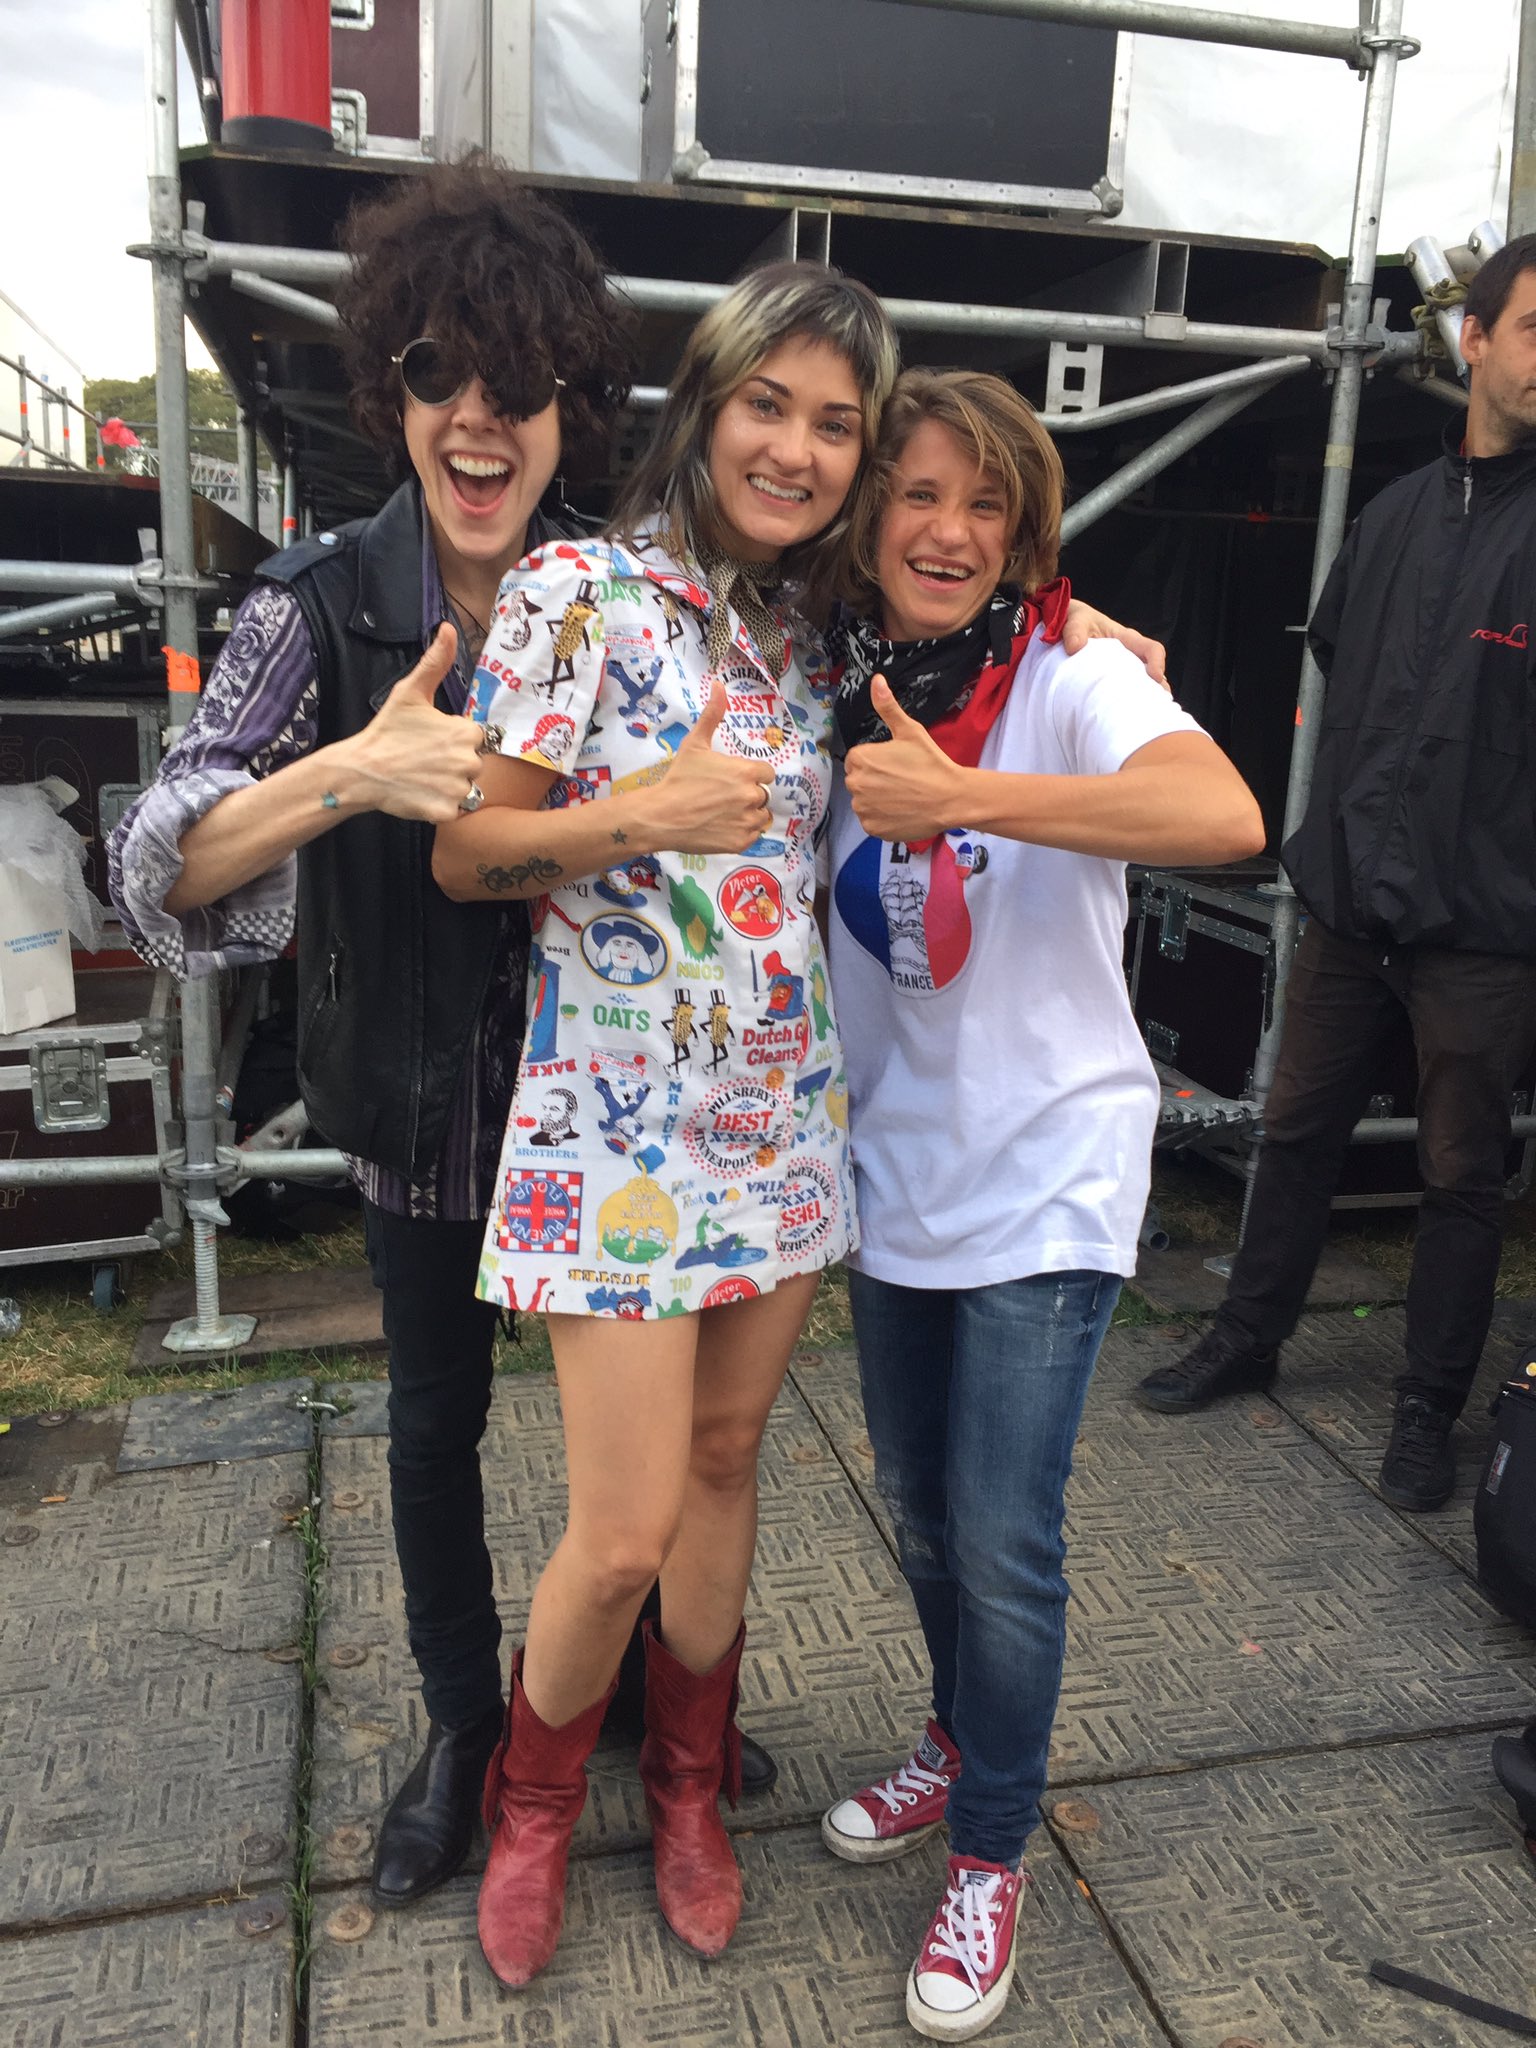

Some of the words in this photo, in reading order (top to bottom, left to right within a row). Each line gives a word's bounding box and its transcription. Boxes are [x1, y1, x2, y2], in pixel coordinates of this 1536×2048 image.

[892, 972, 934, 990] FRANCE
[593, 1004, 650, 1032] OATS
[742, 1025, 793, 1046] Dutch
[713, 1110, 773, 1132] BEST
[515, 1148, 579, 1160] BROTHERS
[514, 1181, 562, 1203] FLOUR
